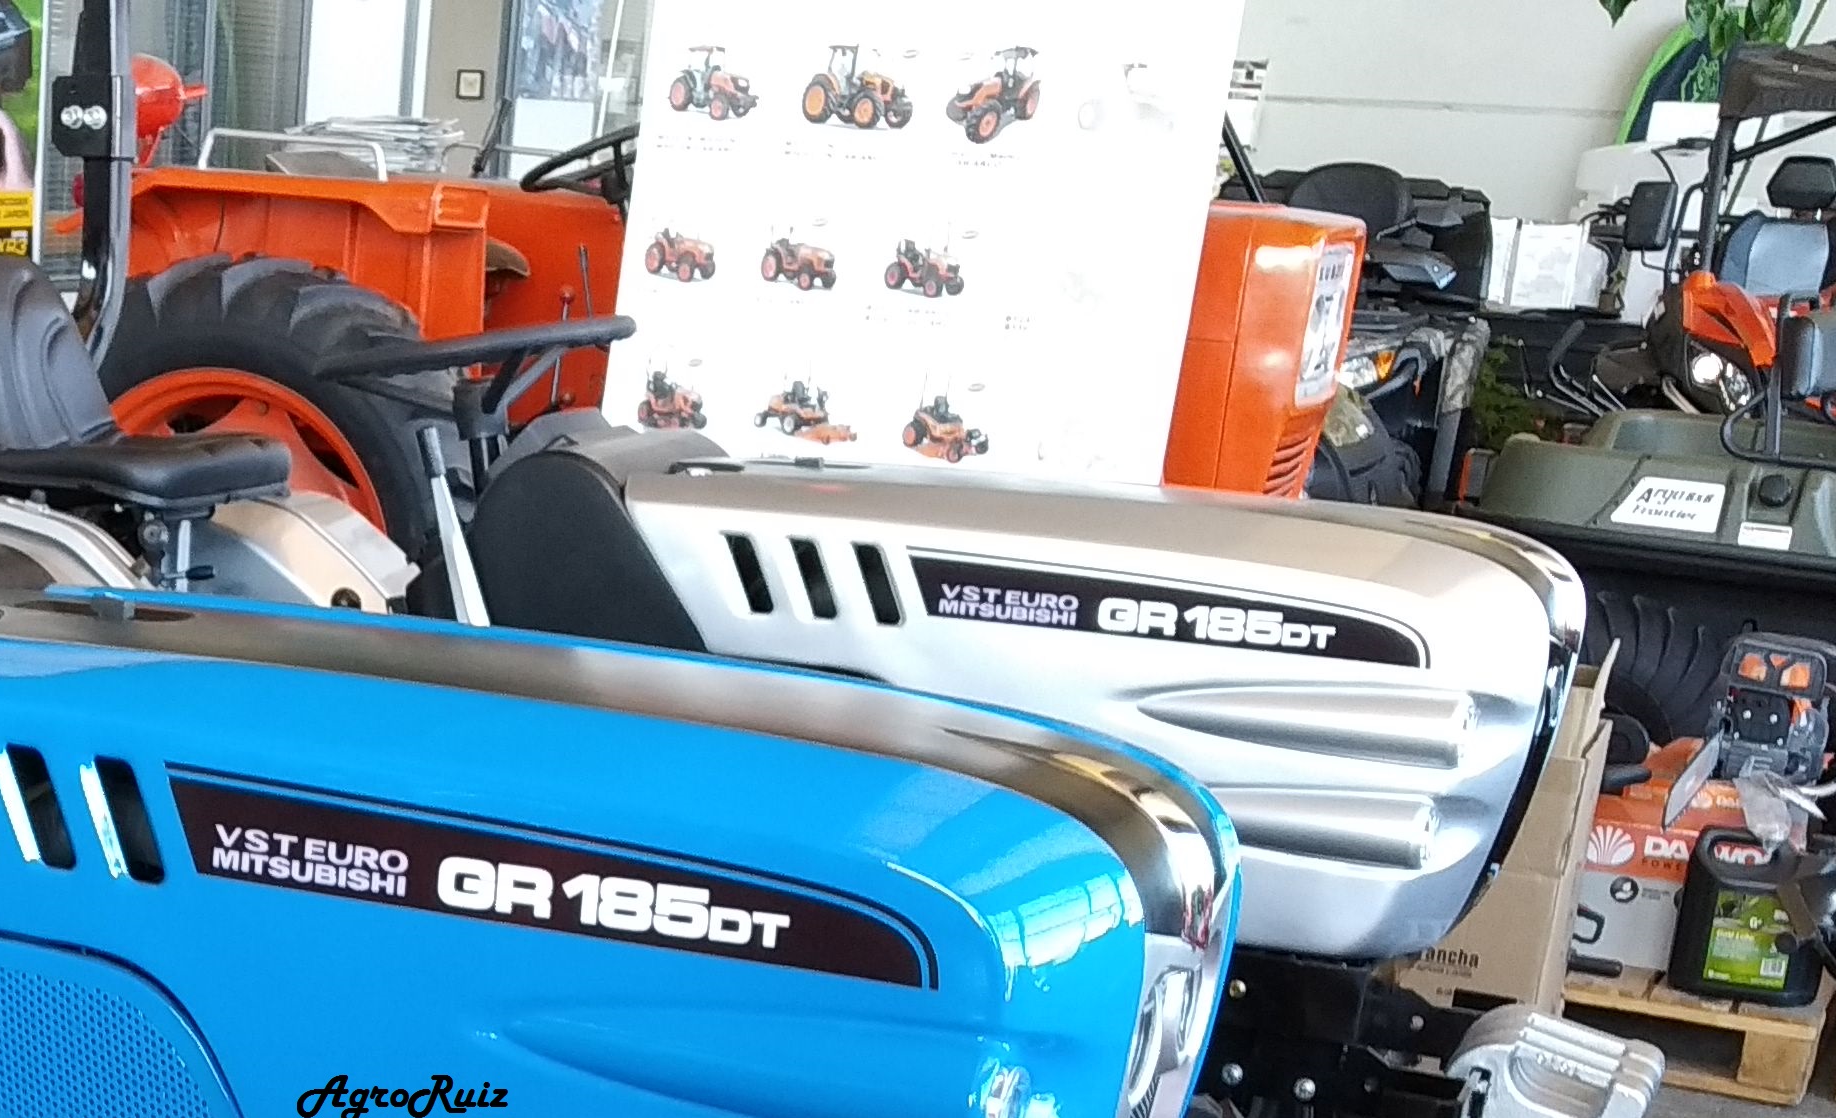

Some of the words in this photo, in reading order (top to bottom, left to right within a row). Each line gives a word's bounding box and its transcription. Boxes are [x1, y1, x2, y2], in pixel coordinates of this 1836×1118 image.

[937, 599, 1077, 627] MITSUBISHI
[941, 583, 1003, 603] VST
[1008, 590, 1080, 611] EURO
[1097, 598, 1179, 637] GR
[214, 823, 299, 858] VST
[304, 838, 409, 874] EURO
[212, 846, 408, 898] MITSUBISHI
[436, 855, 554, 919] GR
